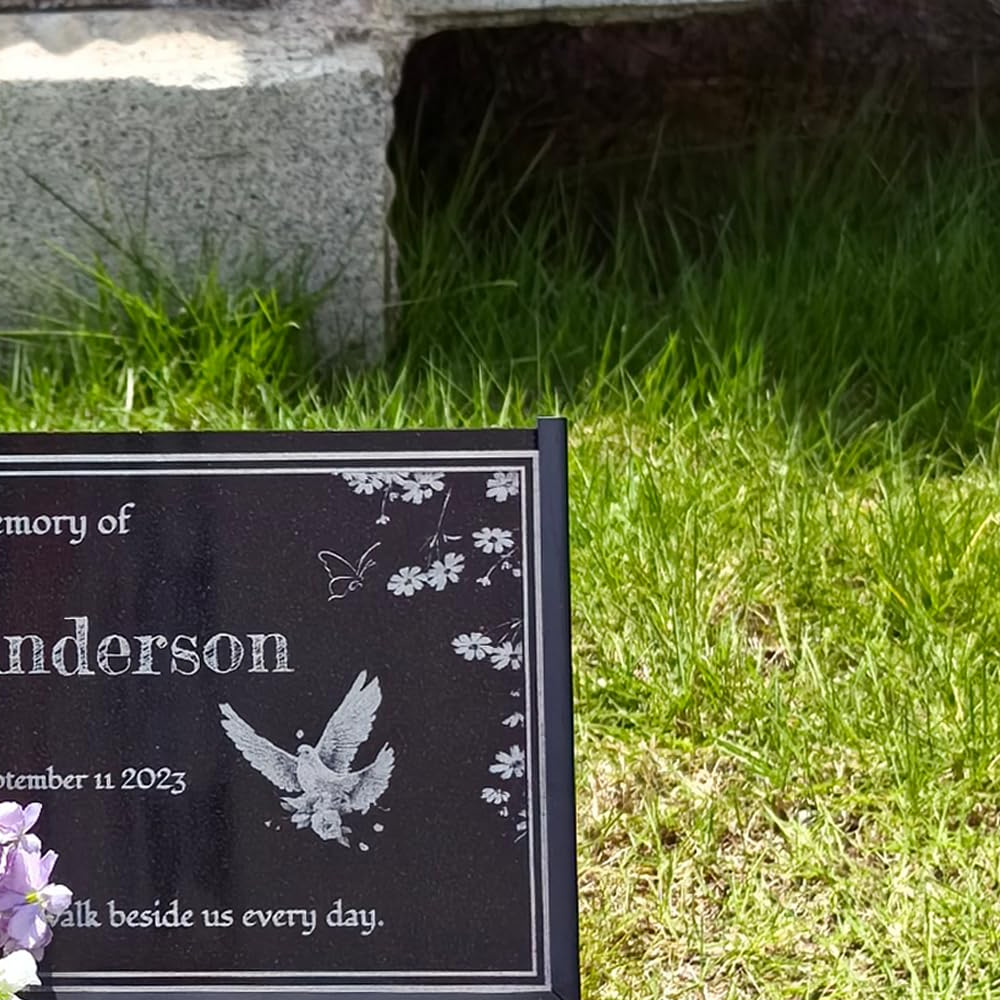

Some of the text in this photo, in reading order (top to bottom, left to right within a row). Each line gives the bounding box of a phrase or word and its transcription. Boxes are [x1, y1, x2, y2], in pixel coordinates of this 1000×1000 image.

[98, 502, 135, 536] of
[94, 772, 116, 790] 11
[121, 767, 187, 795] 2023
[106, 899, 194, 928] beside
[201, 909, 234, 928] us
[242, 909, 317, 936] every
[327, 898, 385, 936] day.
